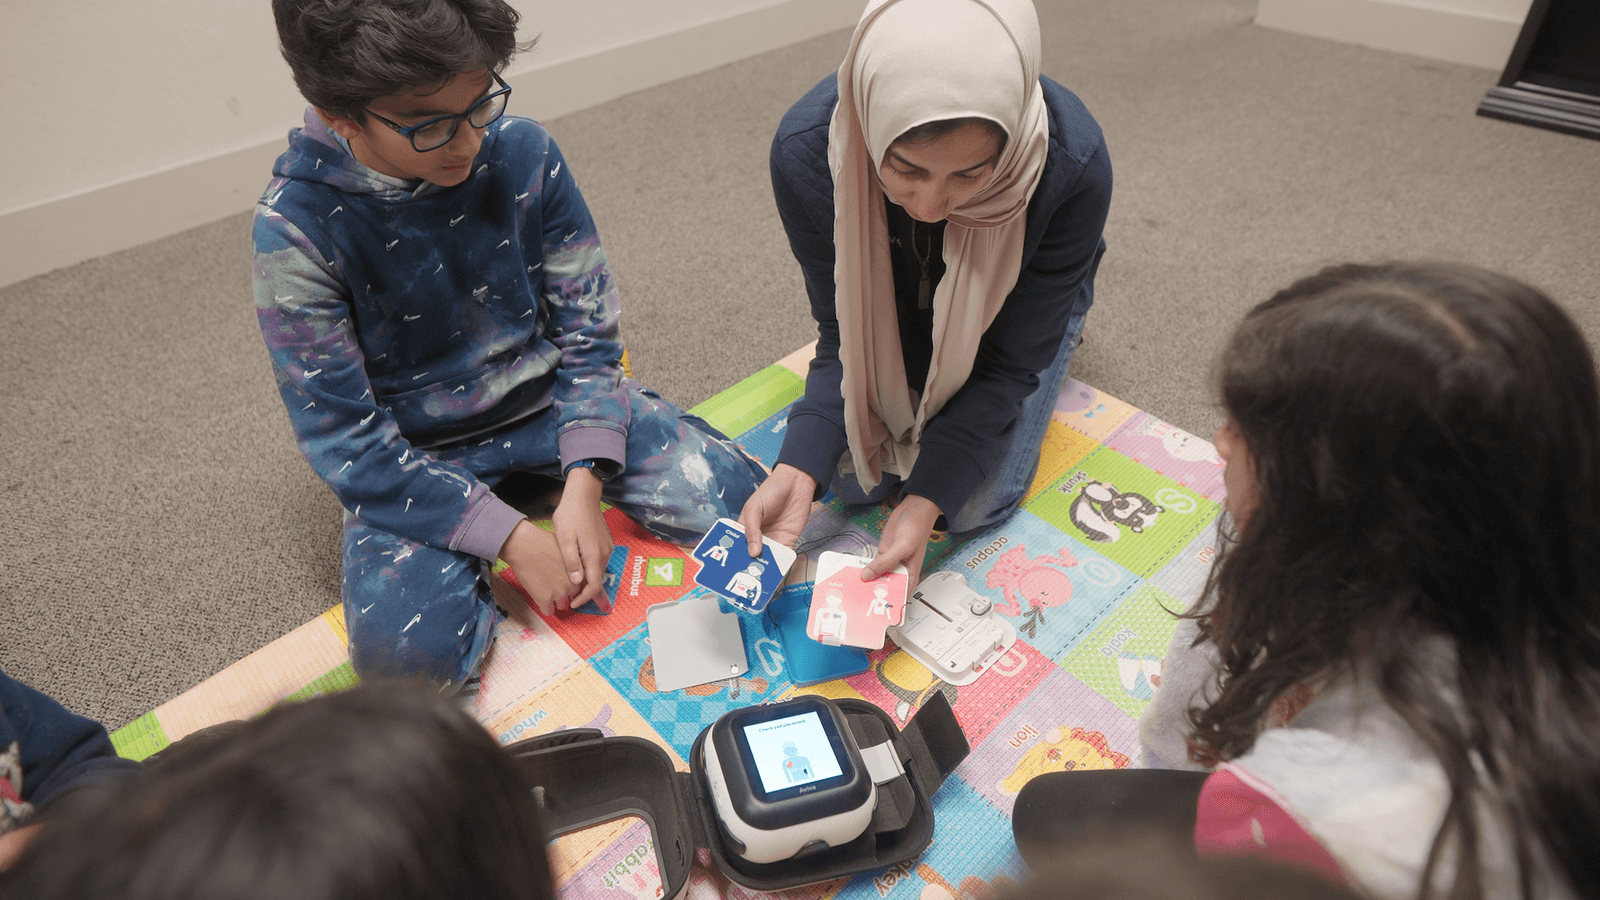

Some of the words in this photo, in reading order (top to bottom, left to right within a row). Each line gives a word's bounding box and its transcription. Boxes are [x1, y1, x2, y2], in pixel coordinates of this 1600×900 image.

[1057, 470, 1088, 495] skunk
[1155, 487, 1197, 514] S
[725, 529, 741, 539] Child
[756, 557, 770, 566] dult
[966, 535, 1009, 571] octopus
[629, 555, 646, 597] rhombus
[654, 562, 674, 582] 4
[1099, 627, 1139, 658] koala
[499, 707, 549, 745] whale
[1009, 722, 1040, 750] lion
[799, 784, 817, 794] Avive
[602, 836, 656, 890] rabbit
[873, 849, 924, 897] nkey
